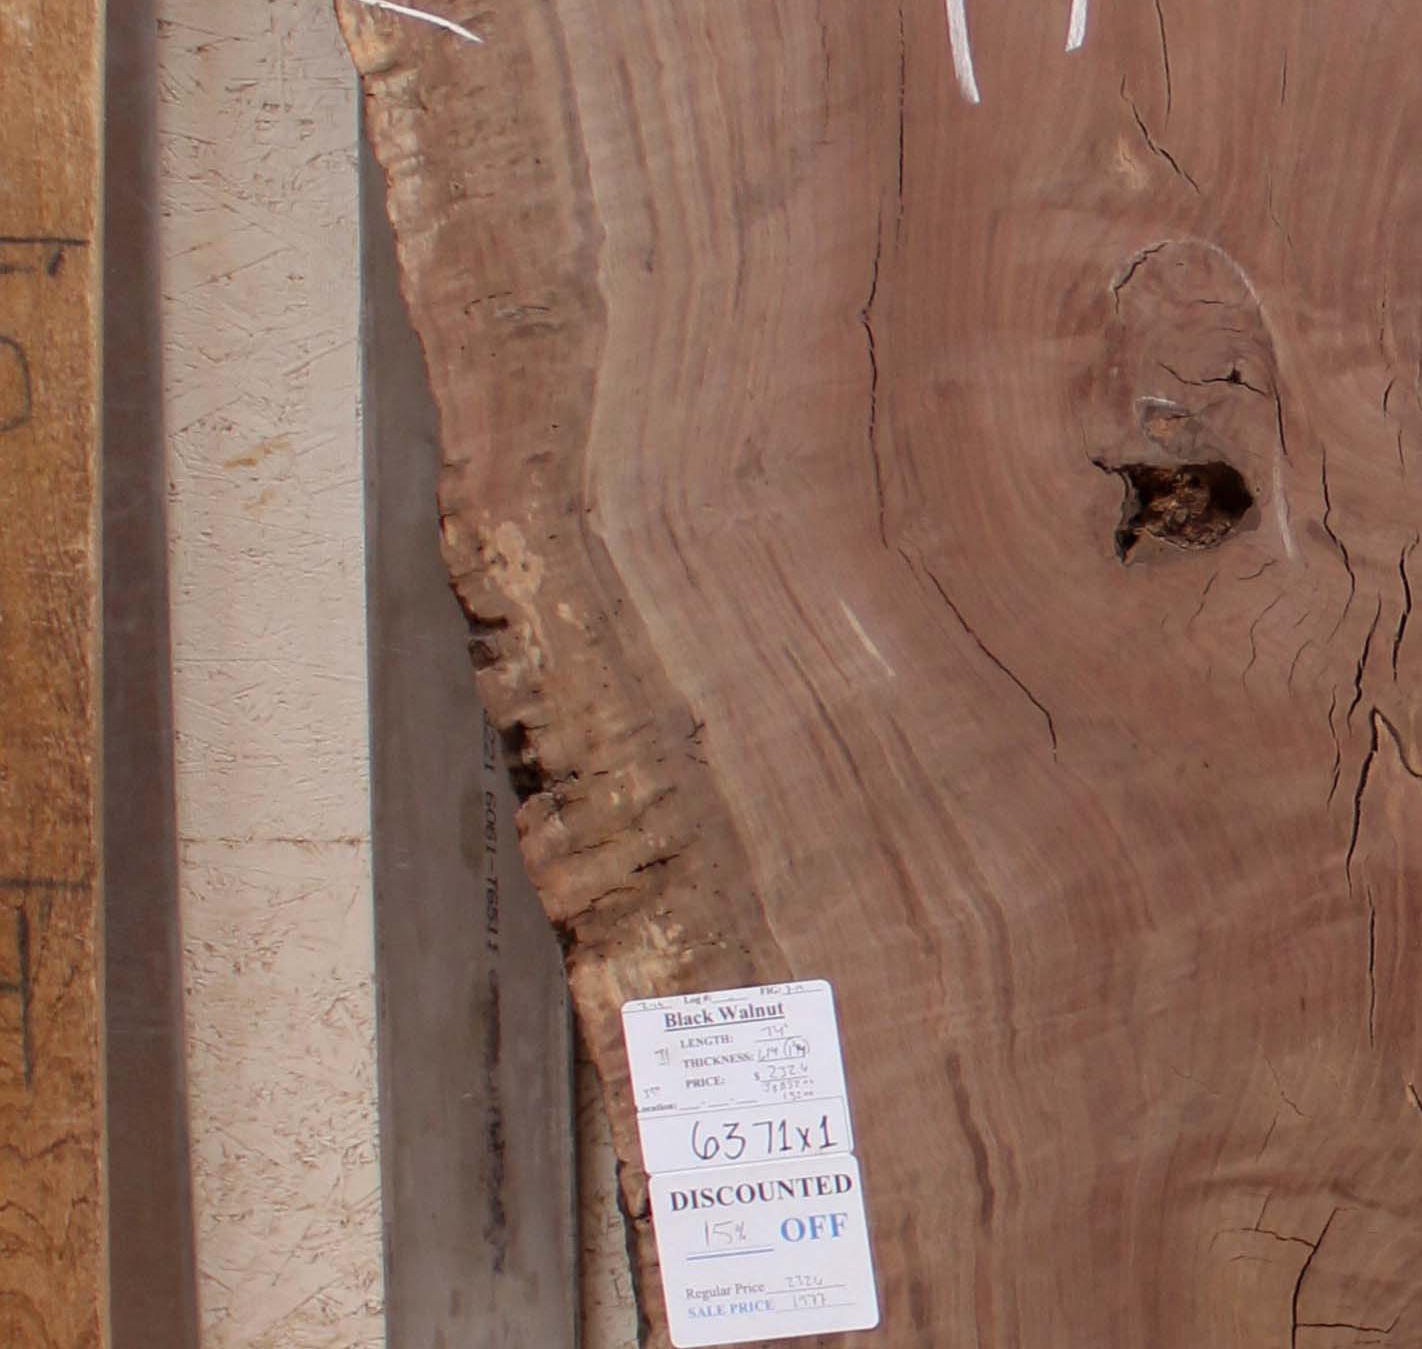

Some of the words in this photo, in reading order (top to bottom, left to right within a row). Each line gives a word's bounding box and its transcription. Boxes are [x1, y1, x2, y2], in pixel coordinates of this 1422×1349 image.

[664, 1010, 714, 1028] Black
[718, 1002, 785, 1021] Walnut
[680, 1034, 733, 1048] LENGTH:
[683, 1053, 755, 1068] THICKNESS:
[685, 1075, 726, 1089] PRICE:
[692, 1115, 838, 1160] 6371x1
[670, 1173, 852, 1211] DISCOUNTED
[780, 1212, 849, 1243] OFF
[686, 1284, 731, 1300] Regular
[735, 1282, 765, 1295] Price
[688, 1304, 726, 1319] SALE
[730, 1299, 774, 1311] PRICE
